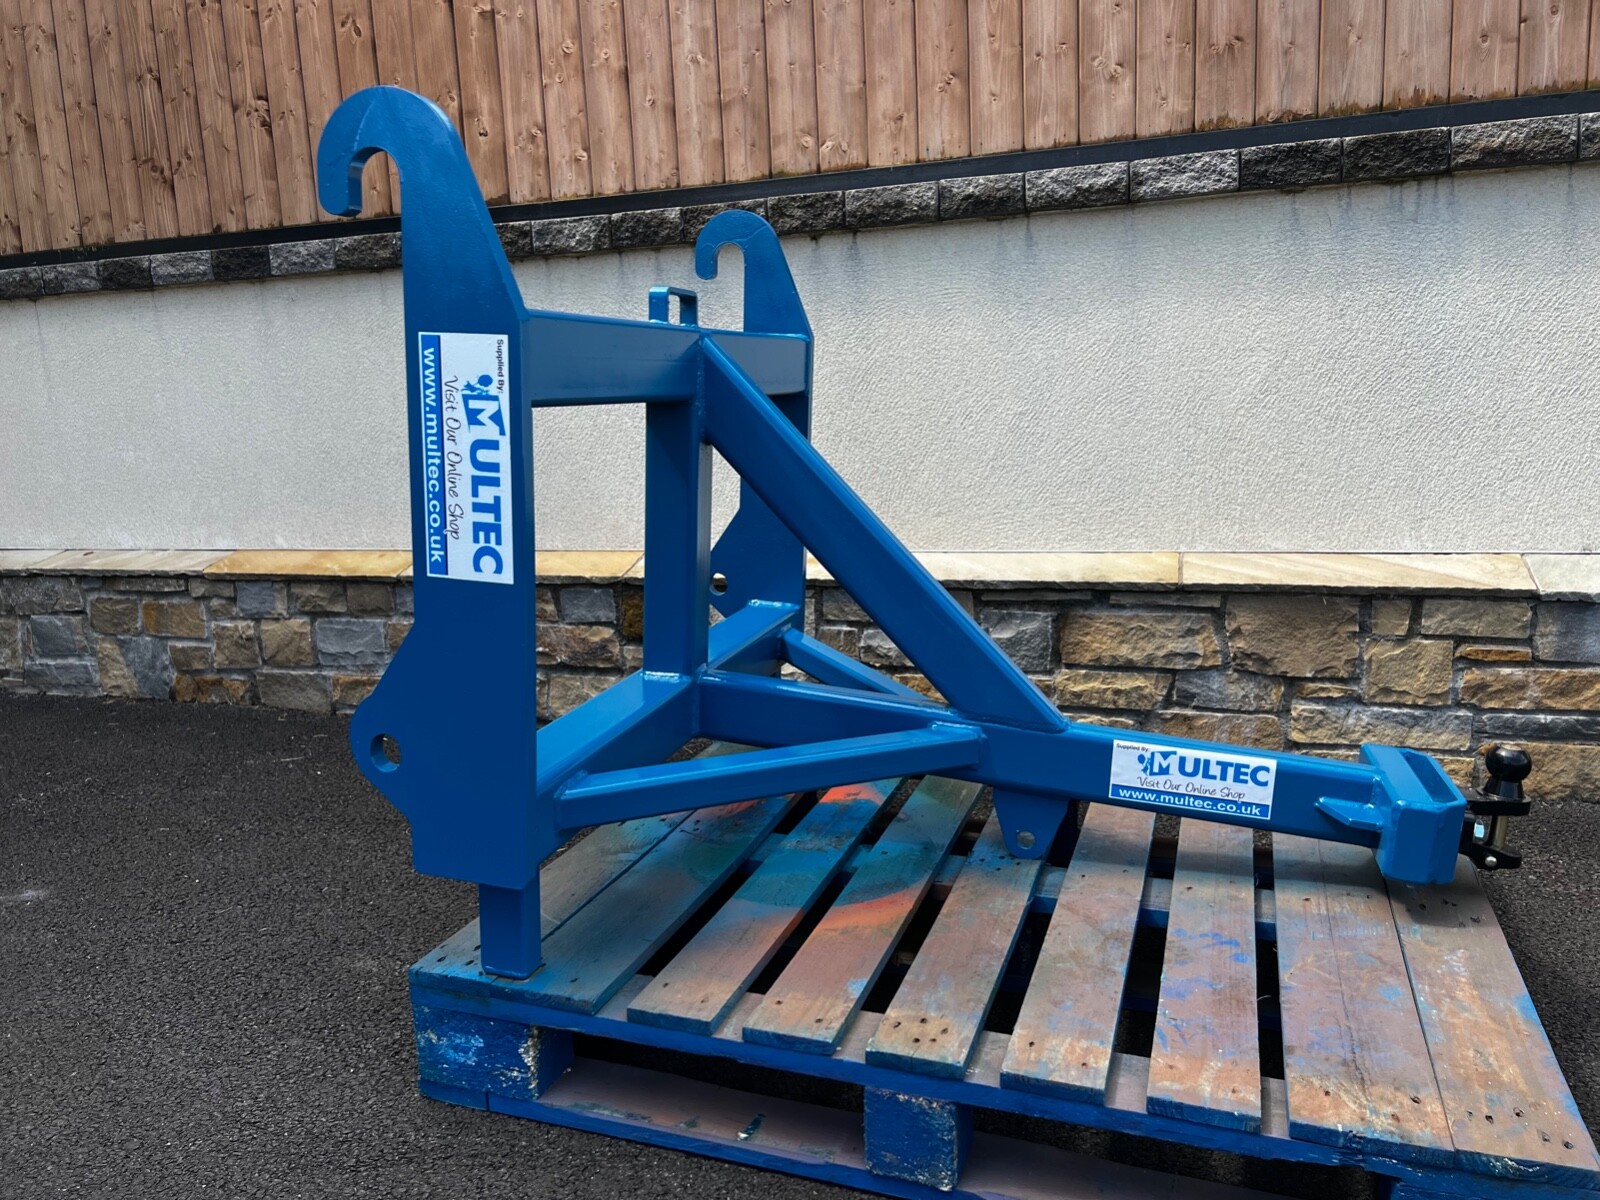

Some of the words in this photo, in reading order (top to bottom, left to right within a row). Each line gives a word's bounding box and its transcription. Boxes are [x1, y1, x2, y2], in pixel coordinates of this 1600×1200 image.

[496, 338, 505, 377] Supplied
[444, 376, 459, 411] Visit
[445, 418, 462, 446] Our
[423, 347, 445, 563] www.multec.co.uk
[447, 451, 463, 498] Online
[461, 393, 506, 575] MULTEC
[443, 503, 464, 540] Shop
[1116, 742, 1140, 751] Supplied
[1149, 750, 1270, 787] MULTEC
[1119, 787, 1261, 816] www.multec.co.uk
[1137, 776, 1160, 788] Visit
[1163, 781, 1182, 791] Our
[1185, 782, 1217, 796] Online
[1220, 787, 1245, 804] Shop
